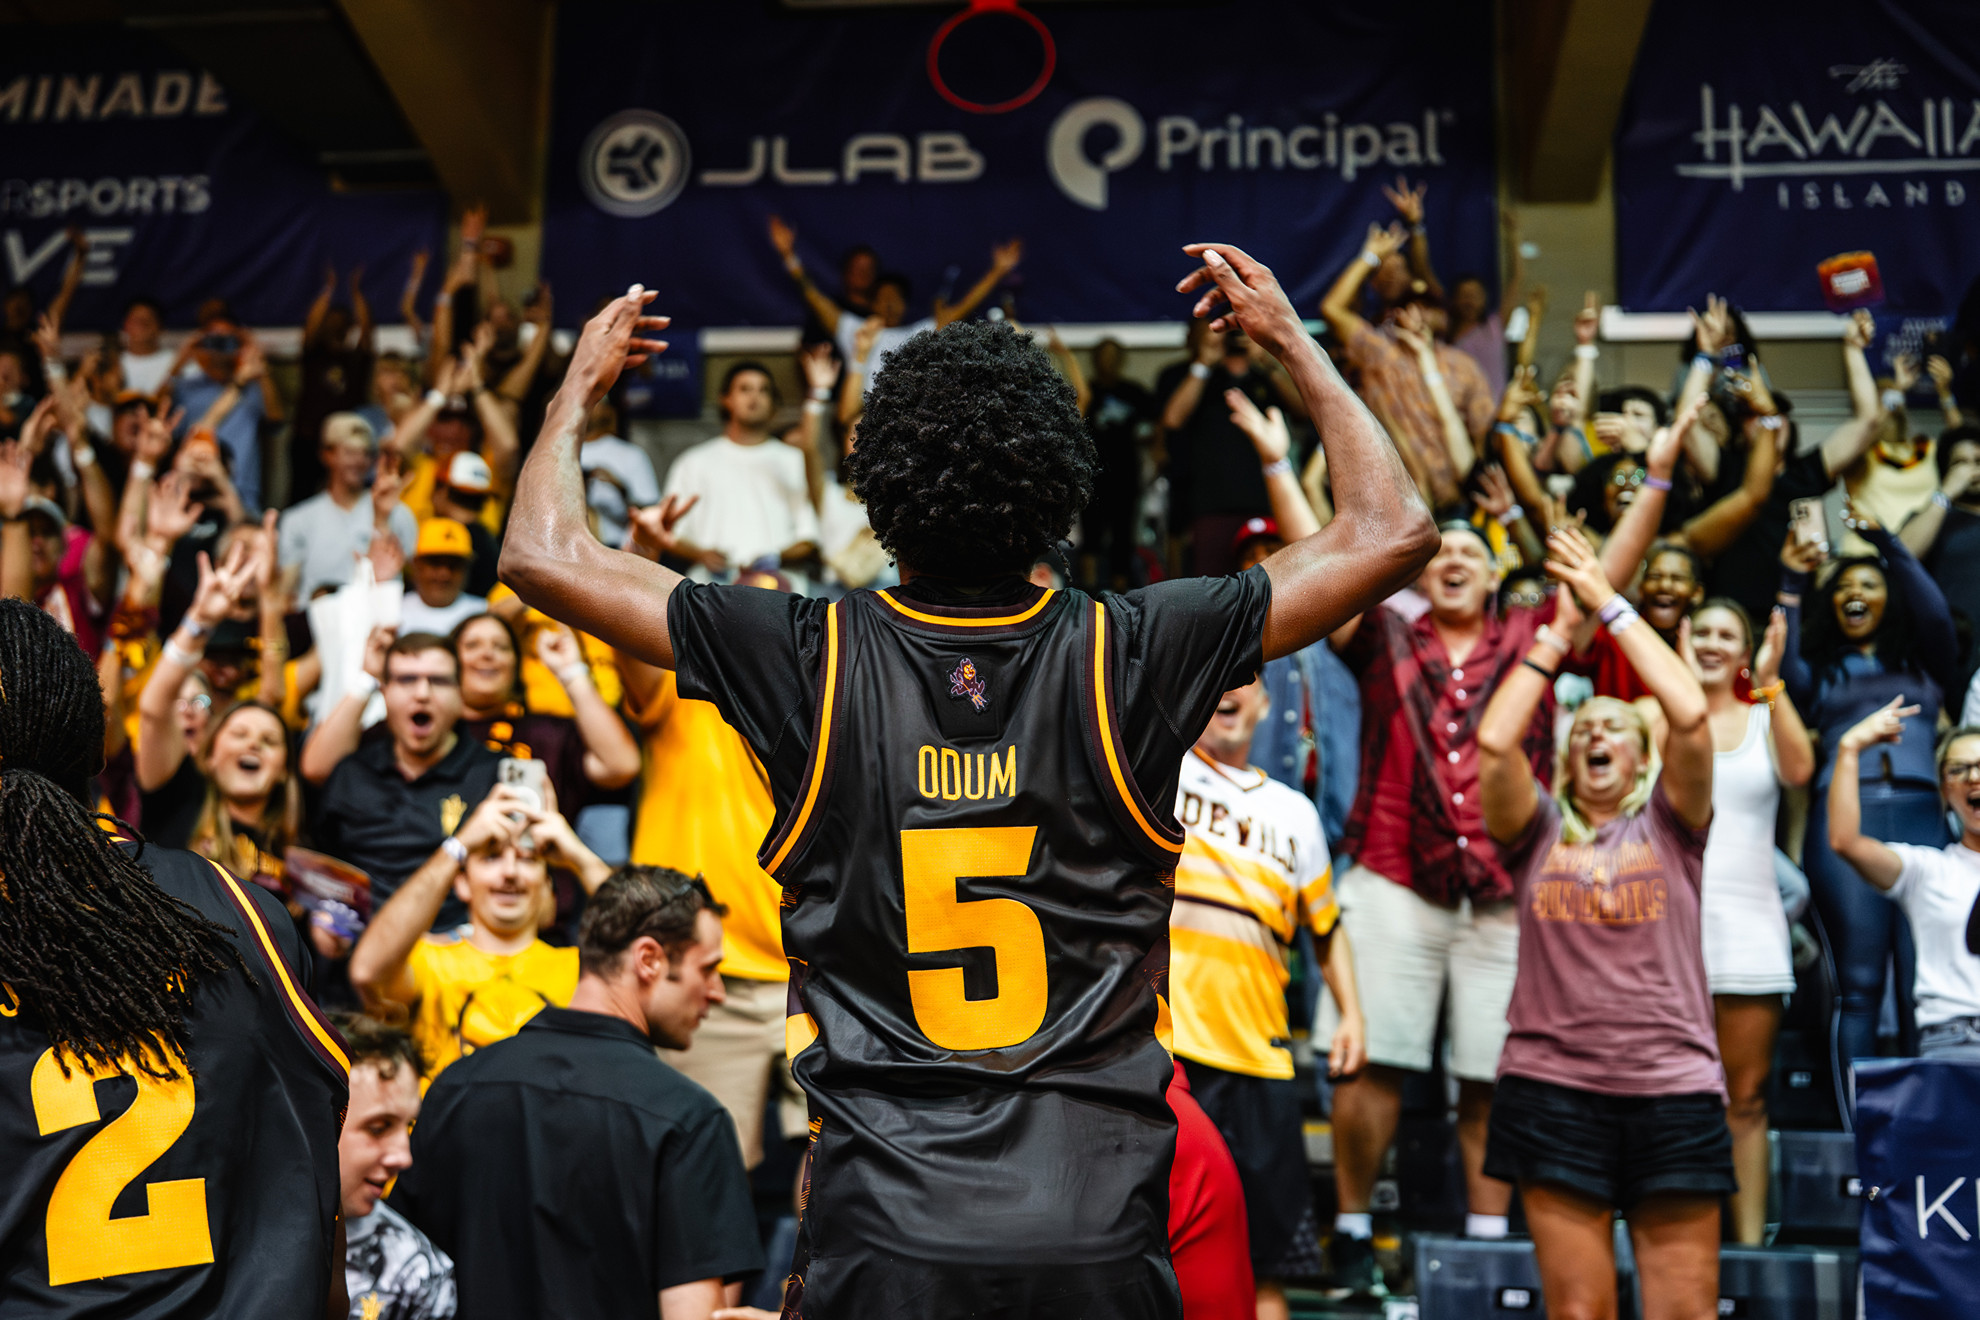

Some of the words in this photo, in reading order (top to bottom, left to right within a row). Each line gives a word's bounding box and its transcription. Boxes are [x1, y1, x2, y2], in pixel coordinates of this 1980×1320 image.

[700, 133, 985, 186] JLAB
[1156, 108, 1446, 182] Principal
[918, 745, 1017, 801] ODUM
[900, 825, 1049, 1052] 5
[30, 1028, 215, 1287] 2
[1915, 1174, 1980, 1242] K
